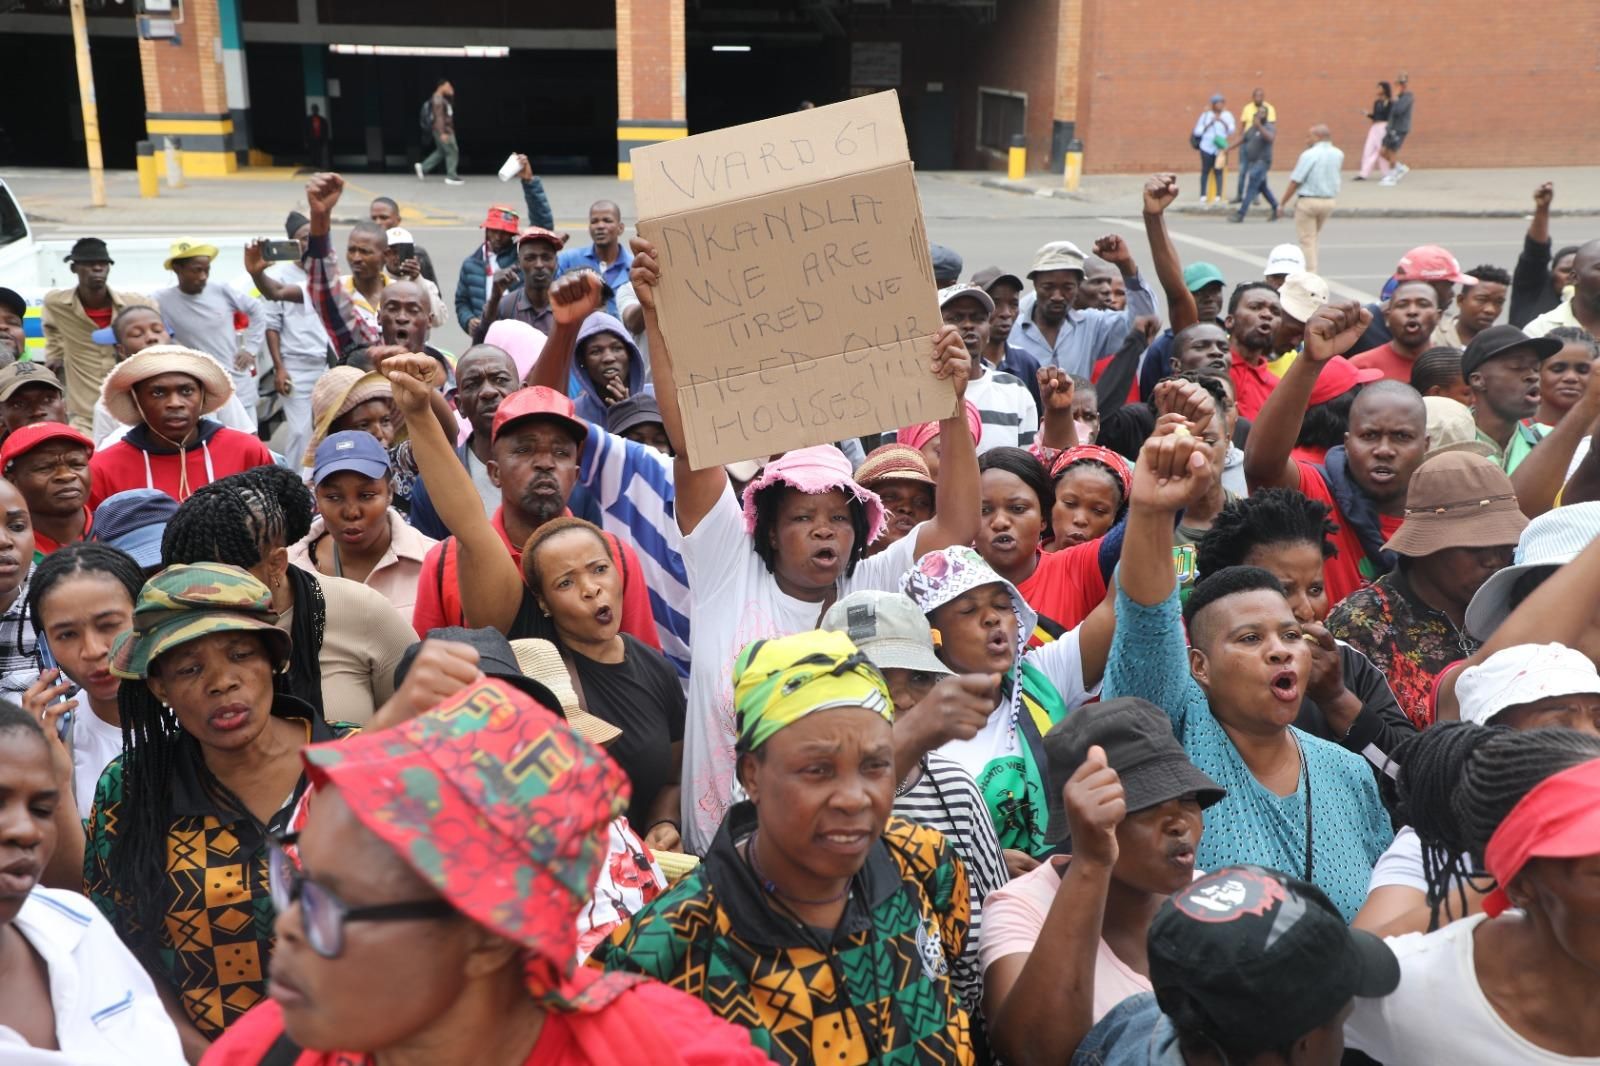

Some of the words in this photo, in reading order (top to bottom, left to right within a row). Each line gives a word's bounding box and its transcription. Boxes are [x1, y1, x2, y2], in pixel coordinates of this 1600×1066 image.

[660, 139, 816, 199] WARD
[834, 120, 879, 156] 67
[662, 194, 883, 267] NKANDLA
[684, 265, 766, 307] WE
[802, 241, 872, 287] ARE
[702, 297, 824, 347] TIRED
[851, 276, 903, 305] WE
[689, 348, 818, 409] NEED
[842, 315, 927, 364] OUR
